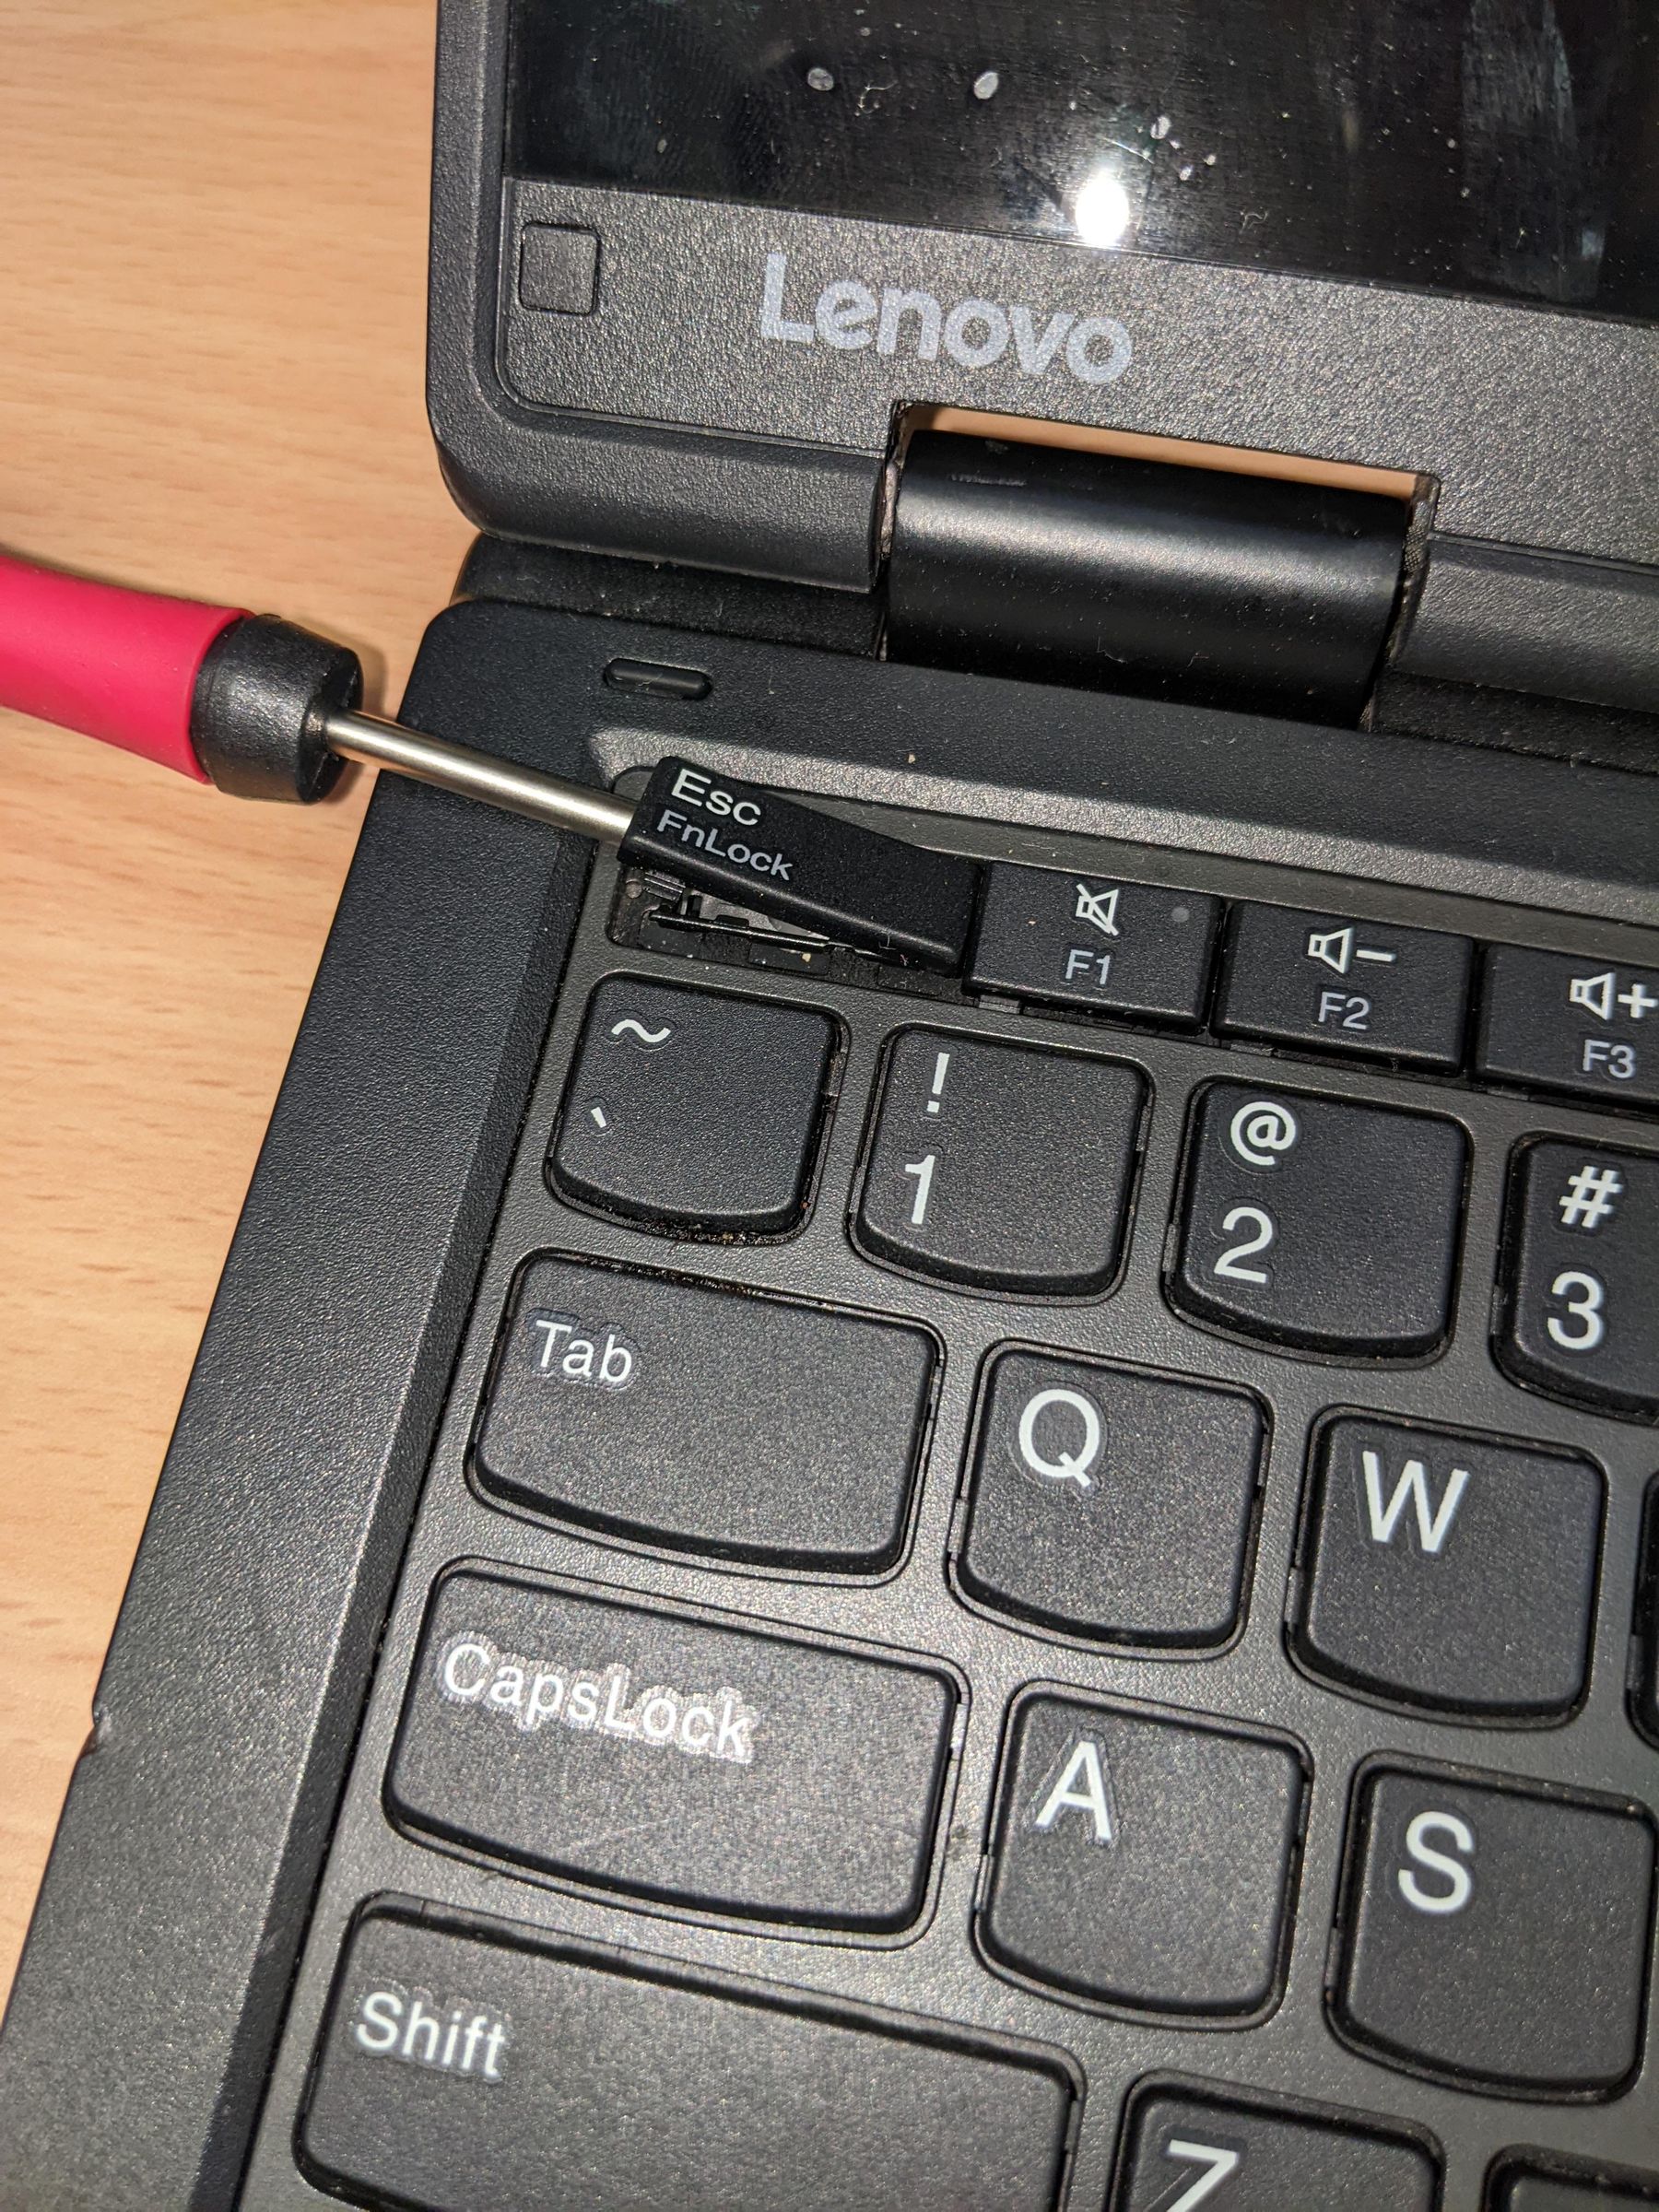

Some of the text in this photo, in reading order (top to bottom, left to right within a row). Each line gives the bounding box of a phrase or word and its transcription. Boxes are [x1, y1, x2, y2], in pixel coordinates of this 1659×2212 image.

[759, 251, 1134, 385] Lenovo
[670, 768, 762, 827] Esc
[656, 808, 794, 881] FnLock
[1065, 948, 1112, 985] F1
[611, 1018, 671, 1043] ~
[1318, 992, 1370, 1030] F2
[927, 1052, 950, 1114] !
[1582, 1039, 1635, 1079] F3
[1230, 1100, 1296, 1166] @
[904, 1154, 936, 1226] 1
[1559, 1166, 1623, 1229] #
[1213, 1206, 1274, 1284] 2
[1547, 1271, 1603, 1350] 3
[535, 1319, 633, 1382] Tab
[1018, 1388, 1101, 1488] Q
[1362, 1451, 1469, 1553] W
[442, 1641, 756, 1761] CapsLock
[1034, 1740, 1112, 1841] A
[1398, 1811, 1473, 1912] S
[355, 1990, 507, 2078] Shift
